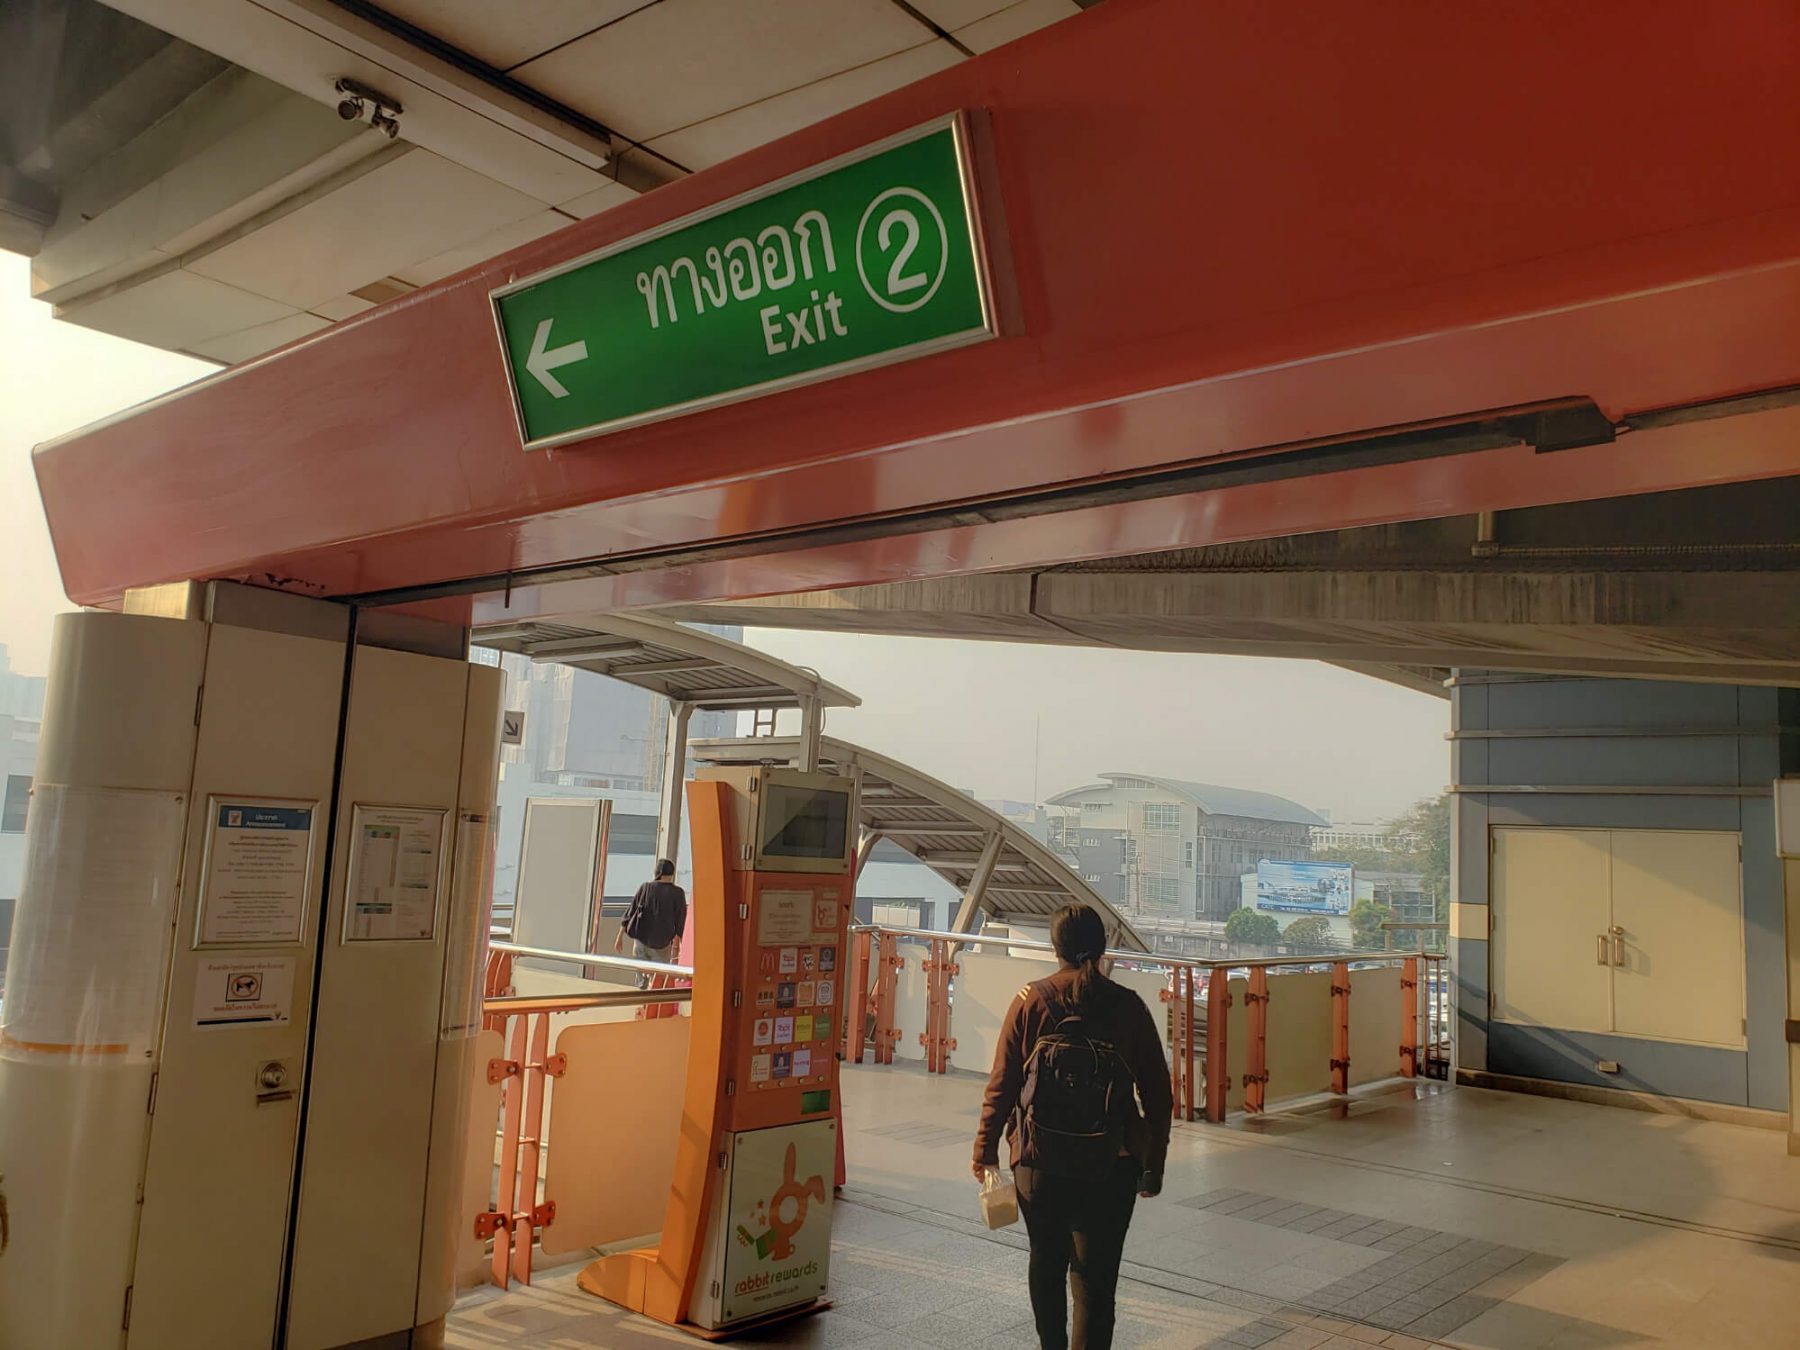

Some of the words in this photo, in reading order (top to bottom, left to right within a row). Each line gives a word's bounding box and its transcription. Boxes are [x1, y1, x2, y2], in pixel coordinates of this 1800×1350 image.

[636, 209, 837, 329] ทางออก
[878, 209, 928, 295] 2
[760, 289, 849, 356] Exit
[735, 1271, 769, 1294] rabbit
[770, 1261, 818, 1283] rewards
